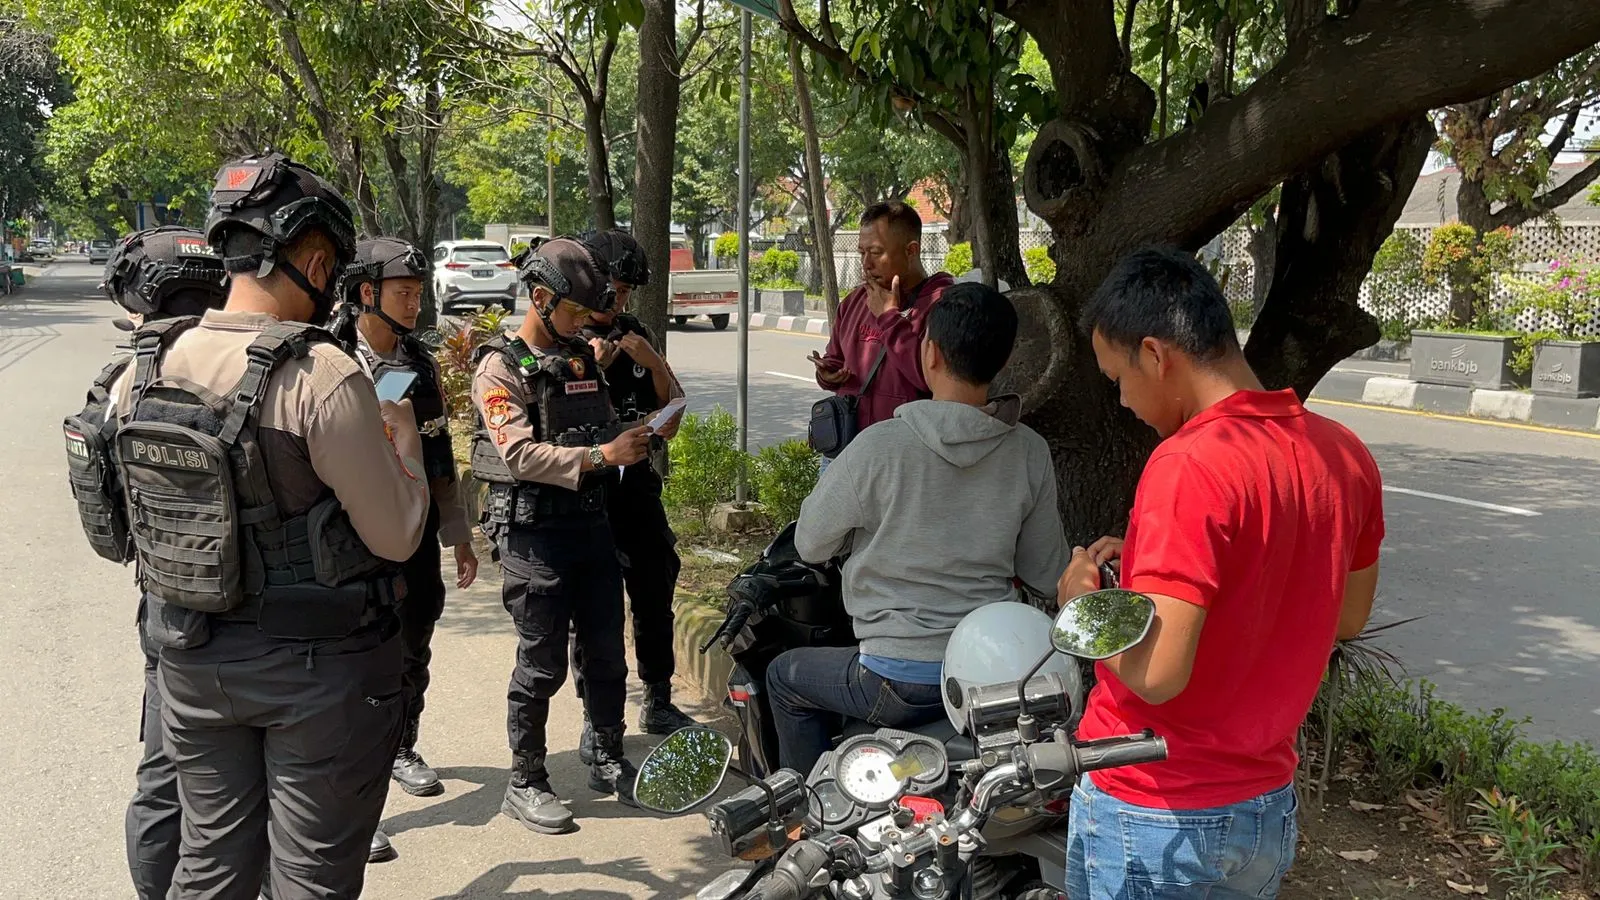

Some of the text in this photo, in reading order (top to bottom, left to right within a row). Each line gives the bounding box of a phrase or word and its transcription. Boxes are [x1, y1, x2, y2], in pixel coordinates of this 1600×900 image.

[181, 243, 215, 256] K5.2
[1431, 357, 1479, 376] bankbjb
[132, 440, 209, 470] POLISI
